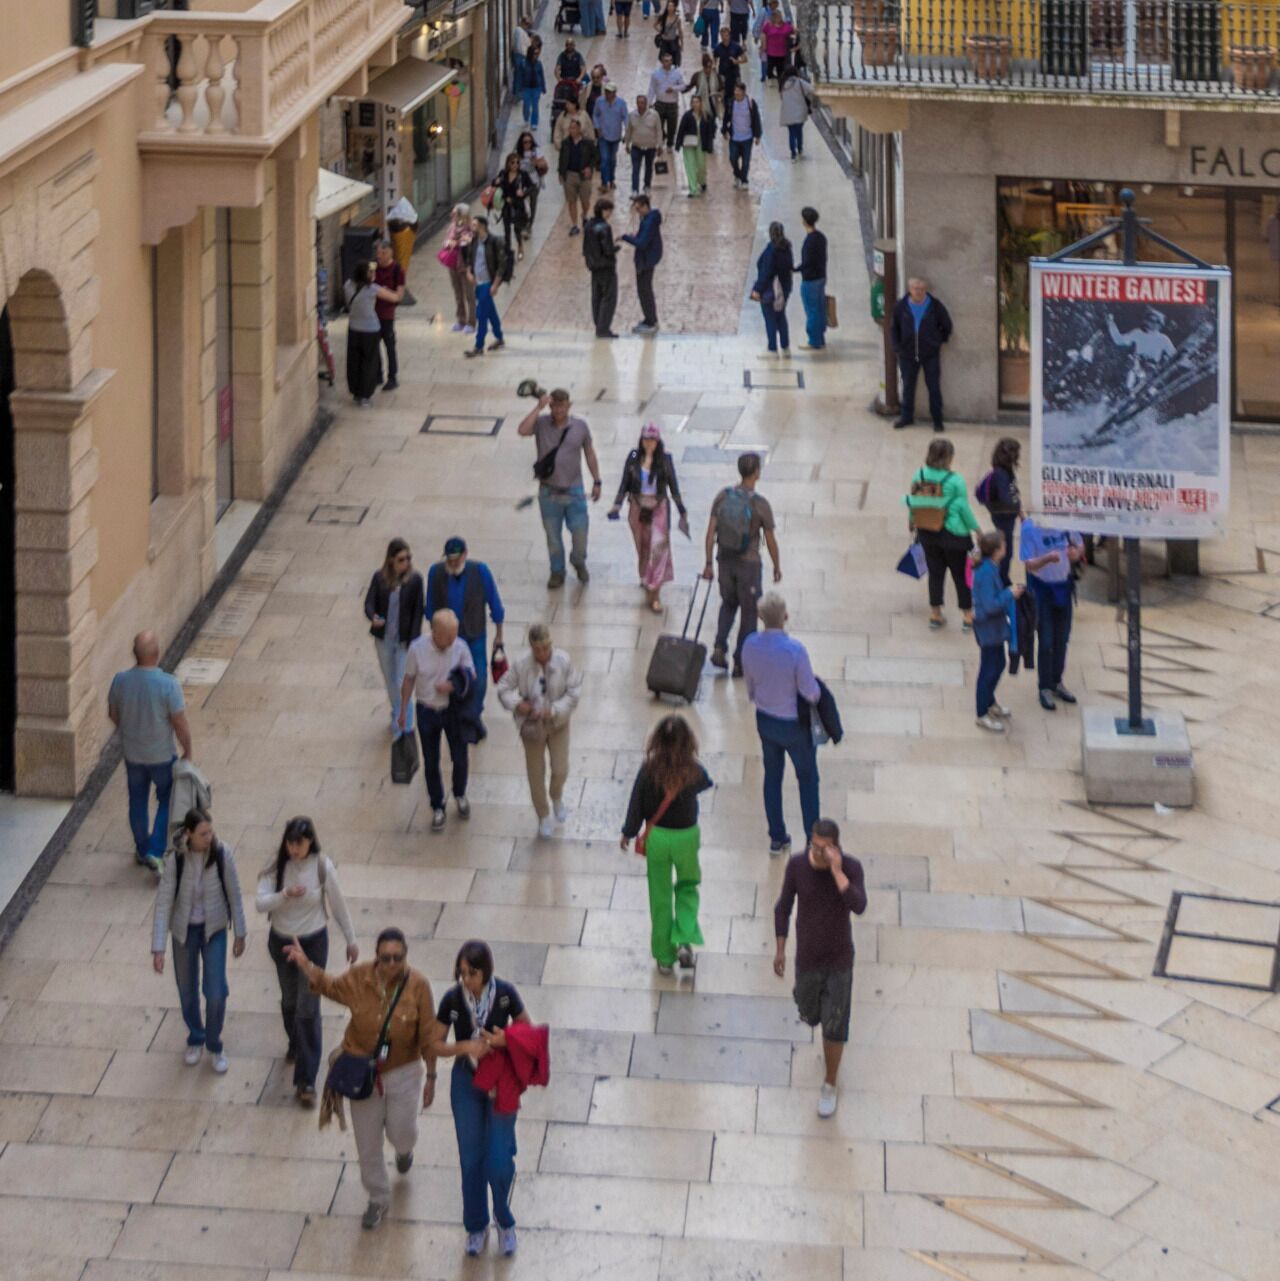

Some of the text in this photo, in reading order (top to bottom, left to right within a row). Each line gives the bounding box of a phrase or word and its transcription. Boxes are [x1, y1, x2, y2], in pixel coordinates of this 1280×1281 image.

[1043, 274, 1205, 304] WINTER GAMES!
[1042, 466, 1062, 481] GLI
[1065, 466, 1104, 486] SPORT
[1108, 470, 1175, 489] INVERNALI
